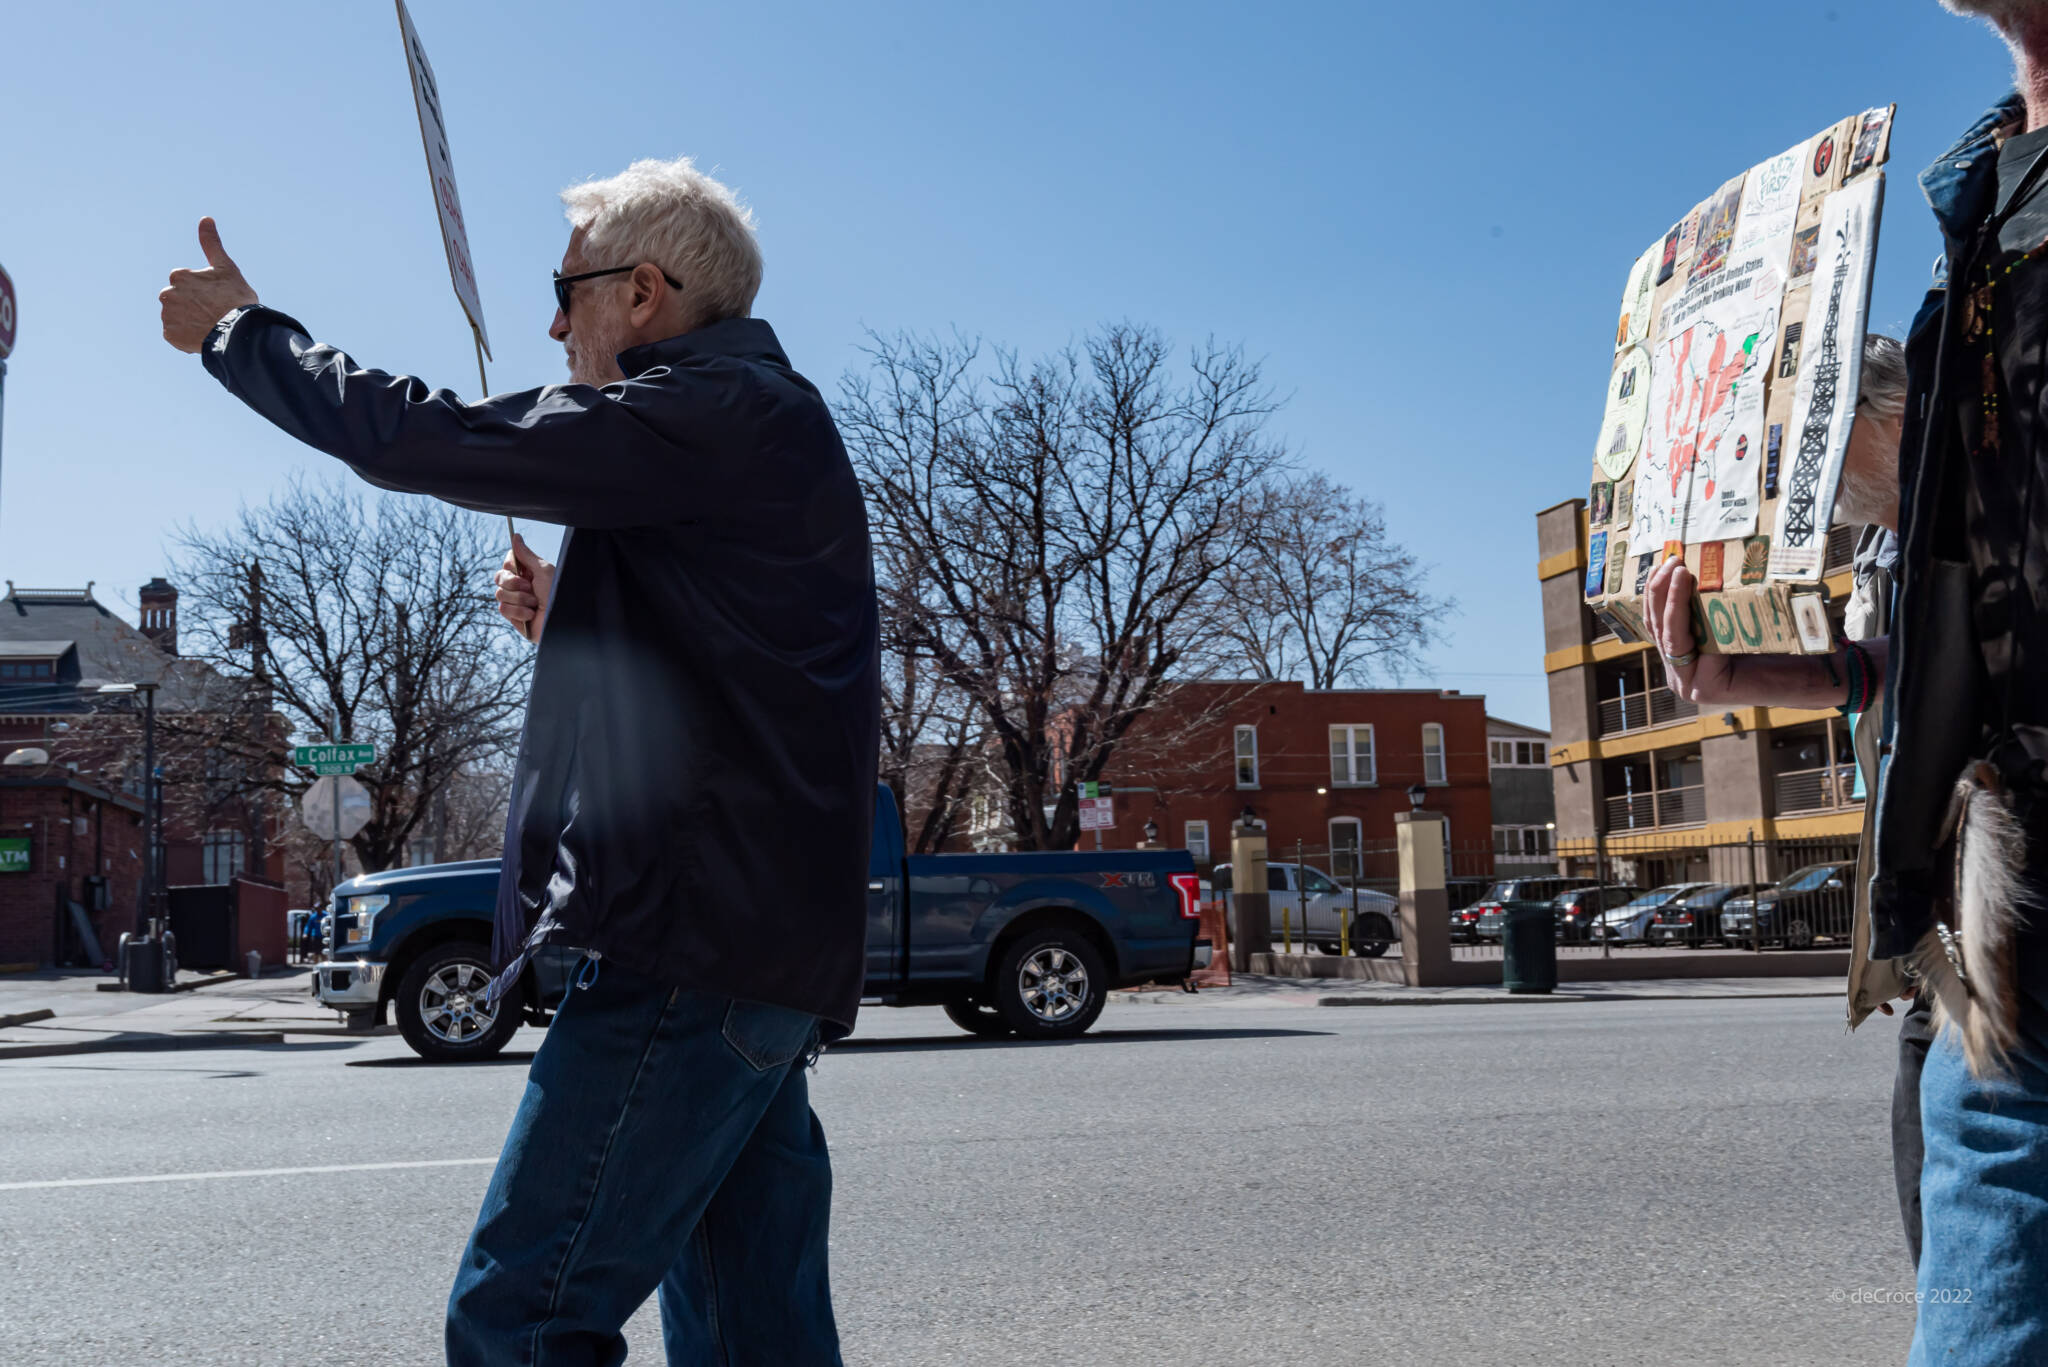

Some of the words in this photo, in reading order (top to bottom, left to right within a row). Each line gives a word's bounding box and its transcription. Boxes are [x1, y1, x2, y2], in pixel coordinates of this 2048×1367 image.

[1726, 263, 1745, 281] United
[1745, 257, 1764, 274] States
[1712, 283, 1735, 302] Drinking
[1734, 277, 1753, 293] Water
[308, 747, 356, 762] Colfax
